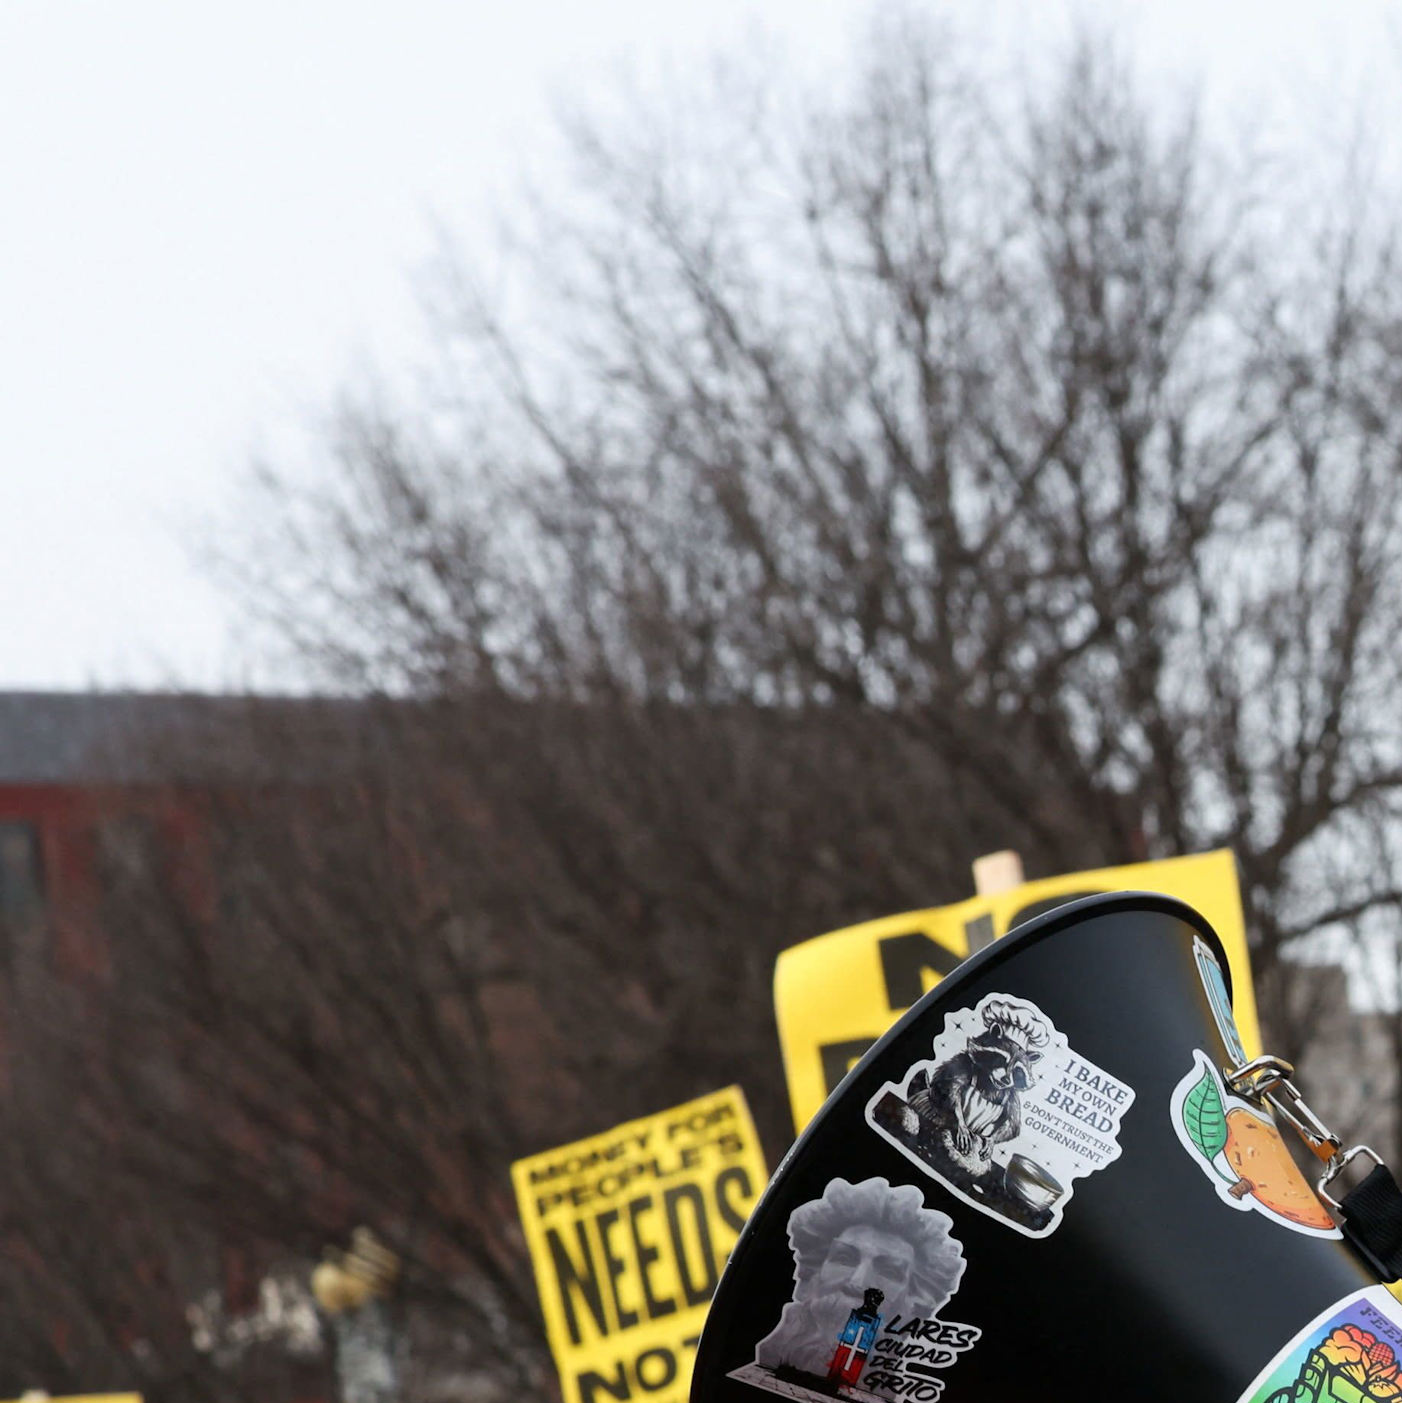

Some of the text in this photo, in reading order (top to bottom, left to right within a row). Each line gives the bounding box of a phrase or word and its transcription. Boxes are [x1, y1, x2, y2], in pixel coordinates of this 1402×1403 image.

[1058, 1077, 1118, 1116] MY OWN
[1064, 1059, 1129, 1105] I BAKE
[667, 1103, 736, 1137] FOR
[1023, 1100, 1115, 1156] & DON'T TRUST THE
[1044, 1087, 1113, 1133] BREAD
[1024, 1115, 1104, 1164] GOVERNMENT
[883, 1314, 978, 1349] LARES
[868, 1355, 904, 1373] DEL
[874, 1338, 953, 1364] CIUDAD
[863, 1370, 942, 1402] GRITO
